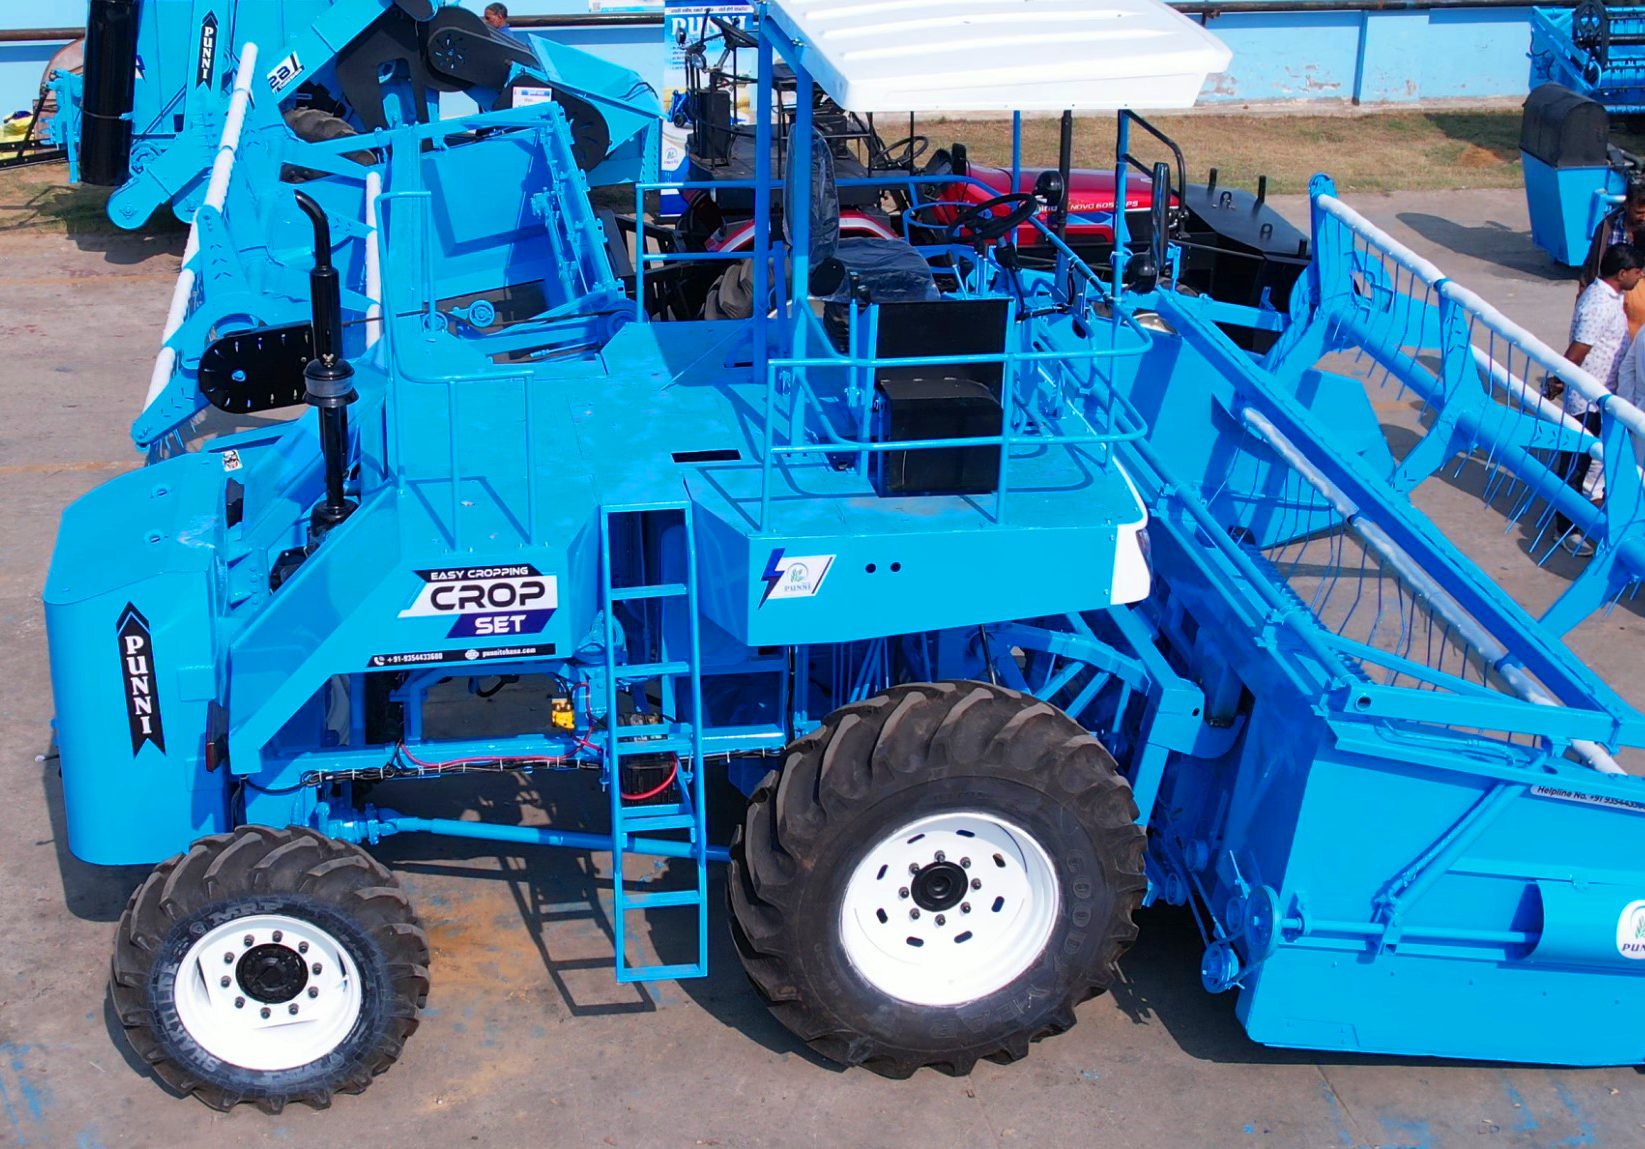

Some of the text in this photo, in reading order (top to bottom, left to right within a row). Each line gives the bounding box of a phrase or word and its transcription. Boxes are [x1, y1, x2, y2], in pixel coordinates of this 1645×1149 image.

[201, 26, 214, 79] PUNNI
[430, 566, 529, 581] EASY CROPPING
[430, 581, 546, 611] CROP
[474, 614, 527, 635] SET
[124, 635, 152, 735] PUNNI
[1537, 785, 1572, 797] Helpline
